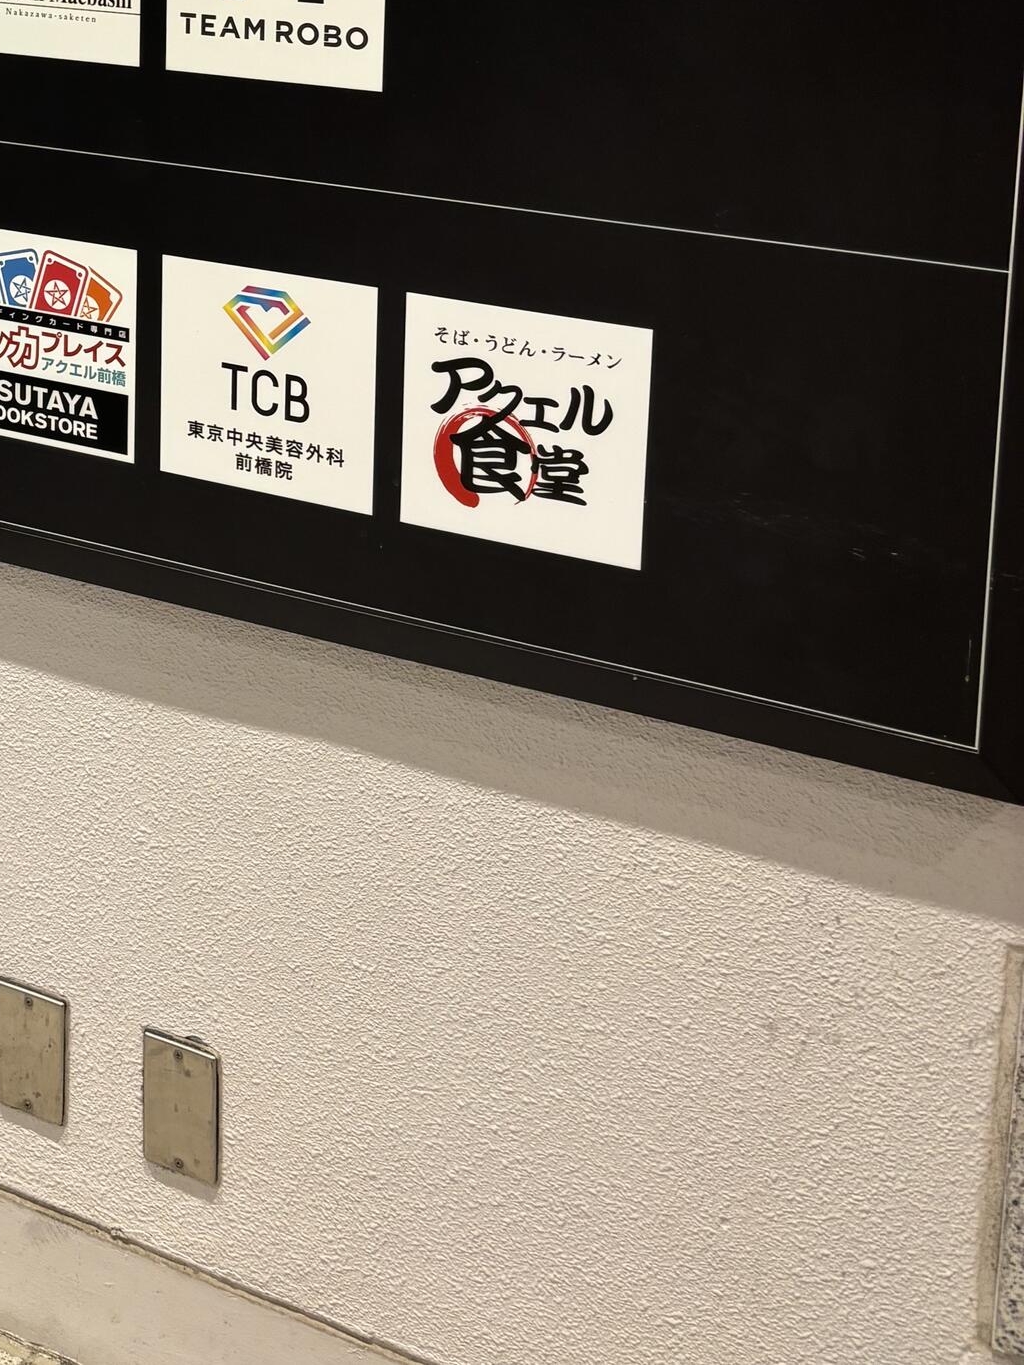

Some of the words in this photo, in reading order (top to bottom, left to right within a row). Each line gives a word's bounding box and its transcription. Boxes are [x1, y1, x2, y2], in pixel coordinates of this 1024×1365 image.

[5, 7, 96, 23] Nakazawa-saketen
[180, 12, 265, 42] TEAM
[275, 20, 369, 50] ROBO
[41, 357, 126, 387] アクエル前橋
[221, 362, 311, 424] TCB
[187, 420, 345, 469] 東京中央美容外科
[449, 415, 590, 506] 食堂
[235, 453, 293, 481] 前橋院
